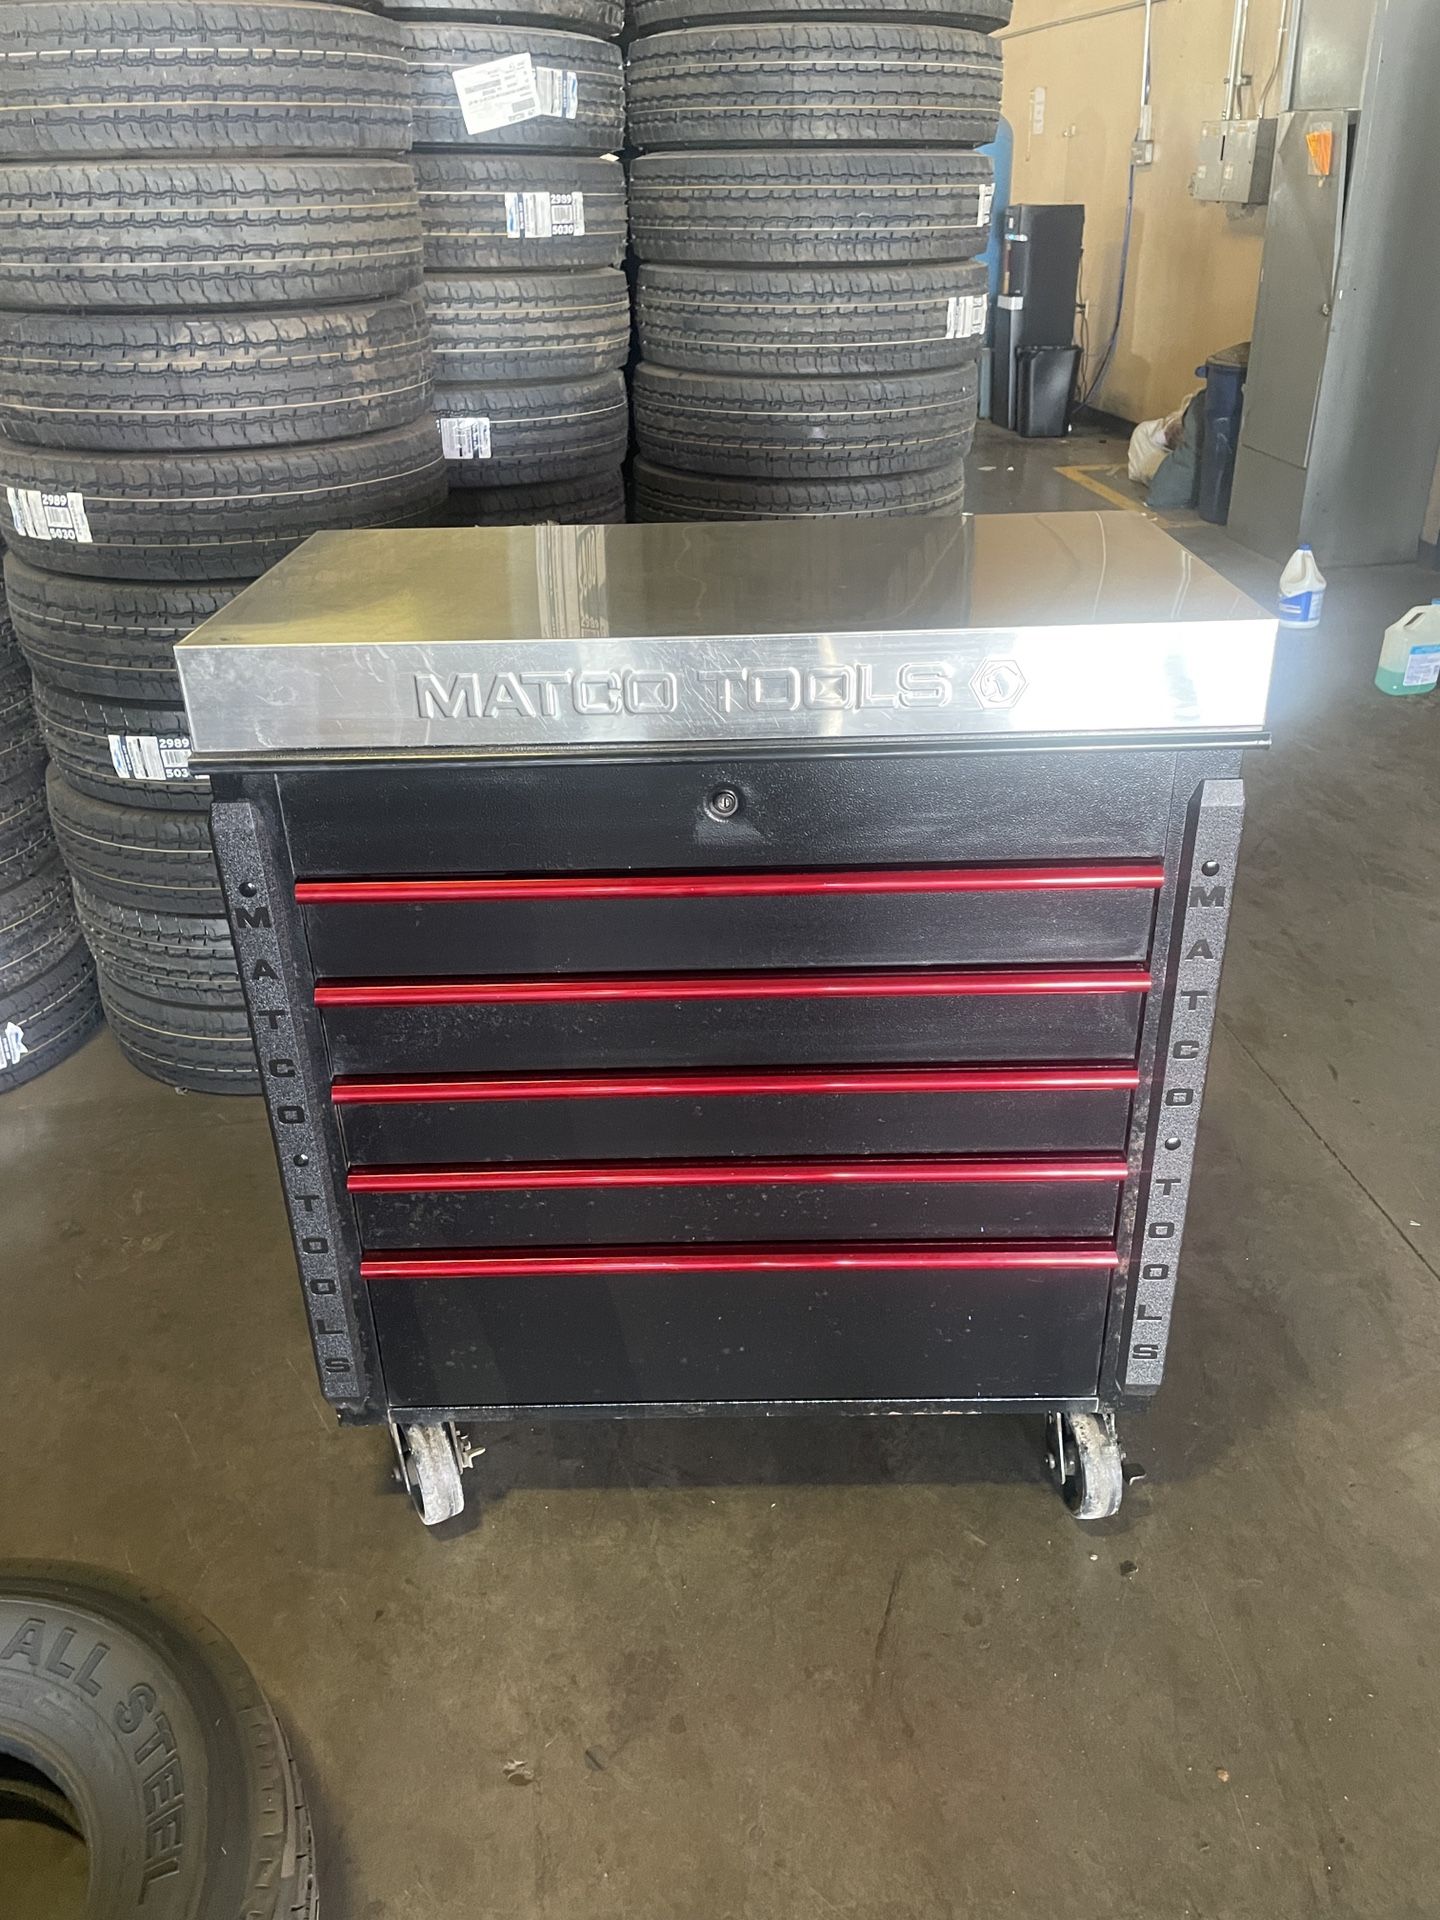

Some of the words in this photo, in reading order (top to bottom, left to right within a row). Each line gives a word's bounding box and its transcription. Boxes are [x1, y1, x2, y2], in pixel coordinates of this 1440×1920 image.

[552, 224, 573, 235] 5030
[41, 493, 67, 507] 2989
[49, 527, 76, 540] 5030
[413, 668, 678, 719] MATCO
[697, 662, 953, 713] TOOLS
[159, 738, 190, 749] 2989
[165, 768, 190, 778] 503
[1164, 885, 1226, 1107] MATCO
[236, 907, 306, 1126] MATCO
[294, 1195, 351, 1375] TOOLS
[1131, 1177, 1182, 1360] TOOLS
[1, 1617, 111, 1698] ALL
[113, 1682, 186, 1906] STEEL
